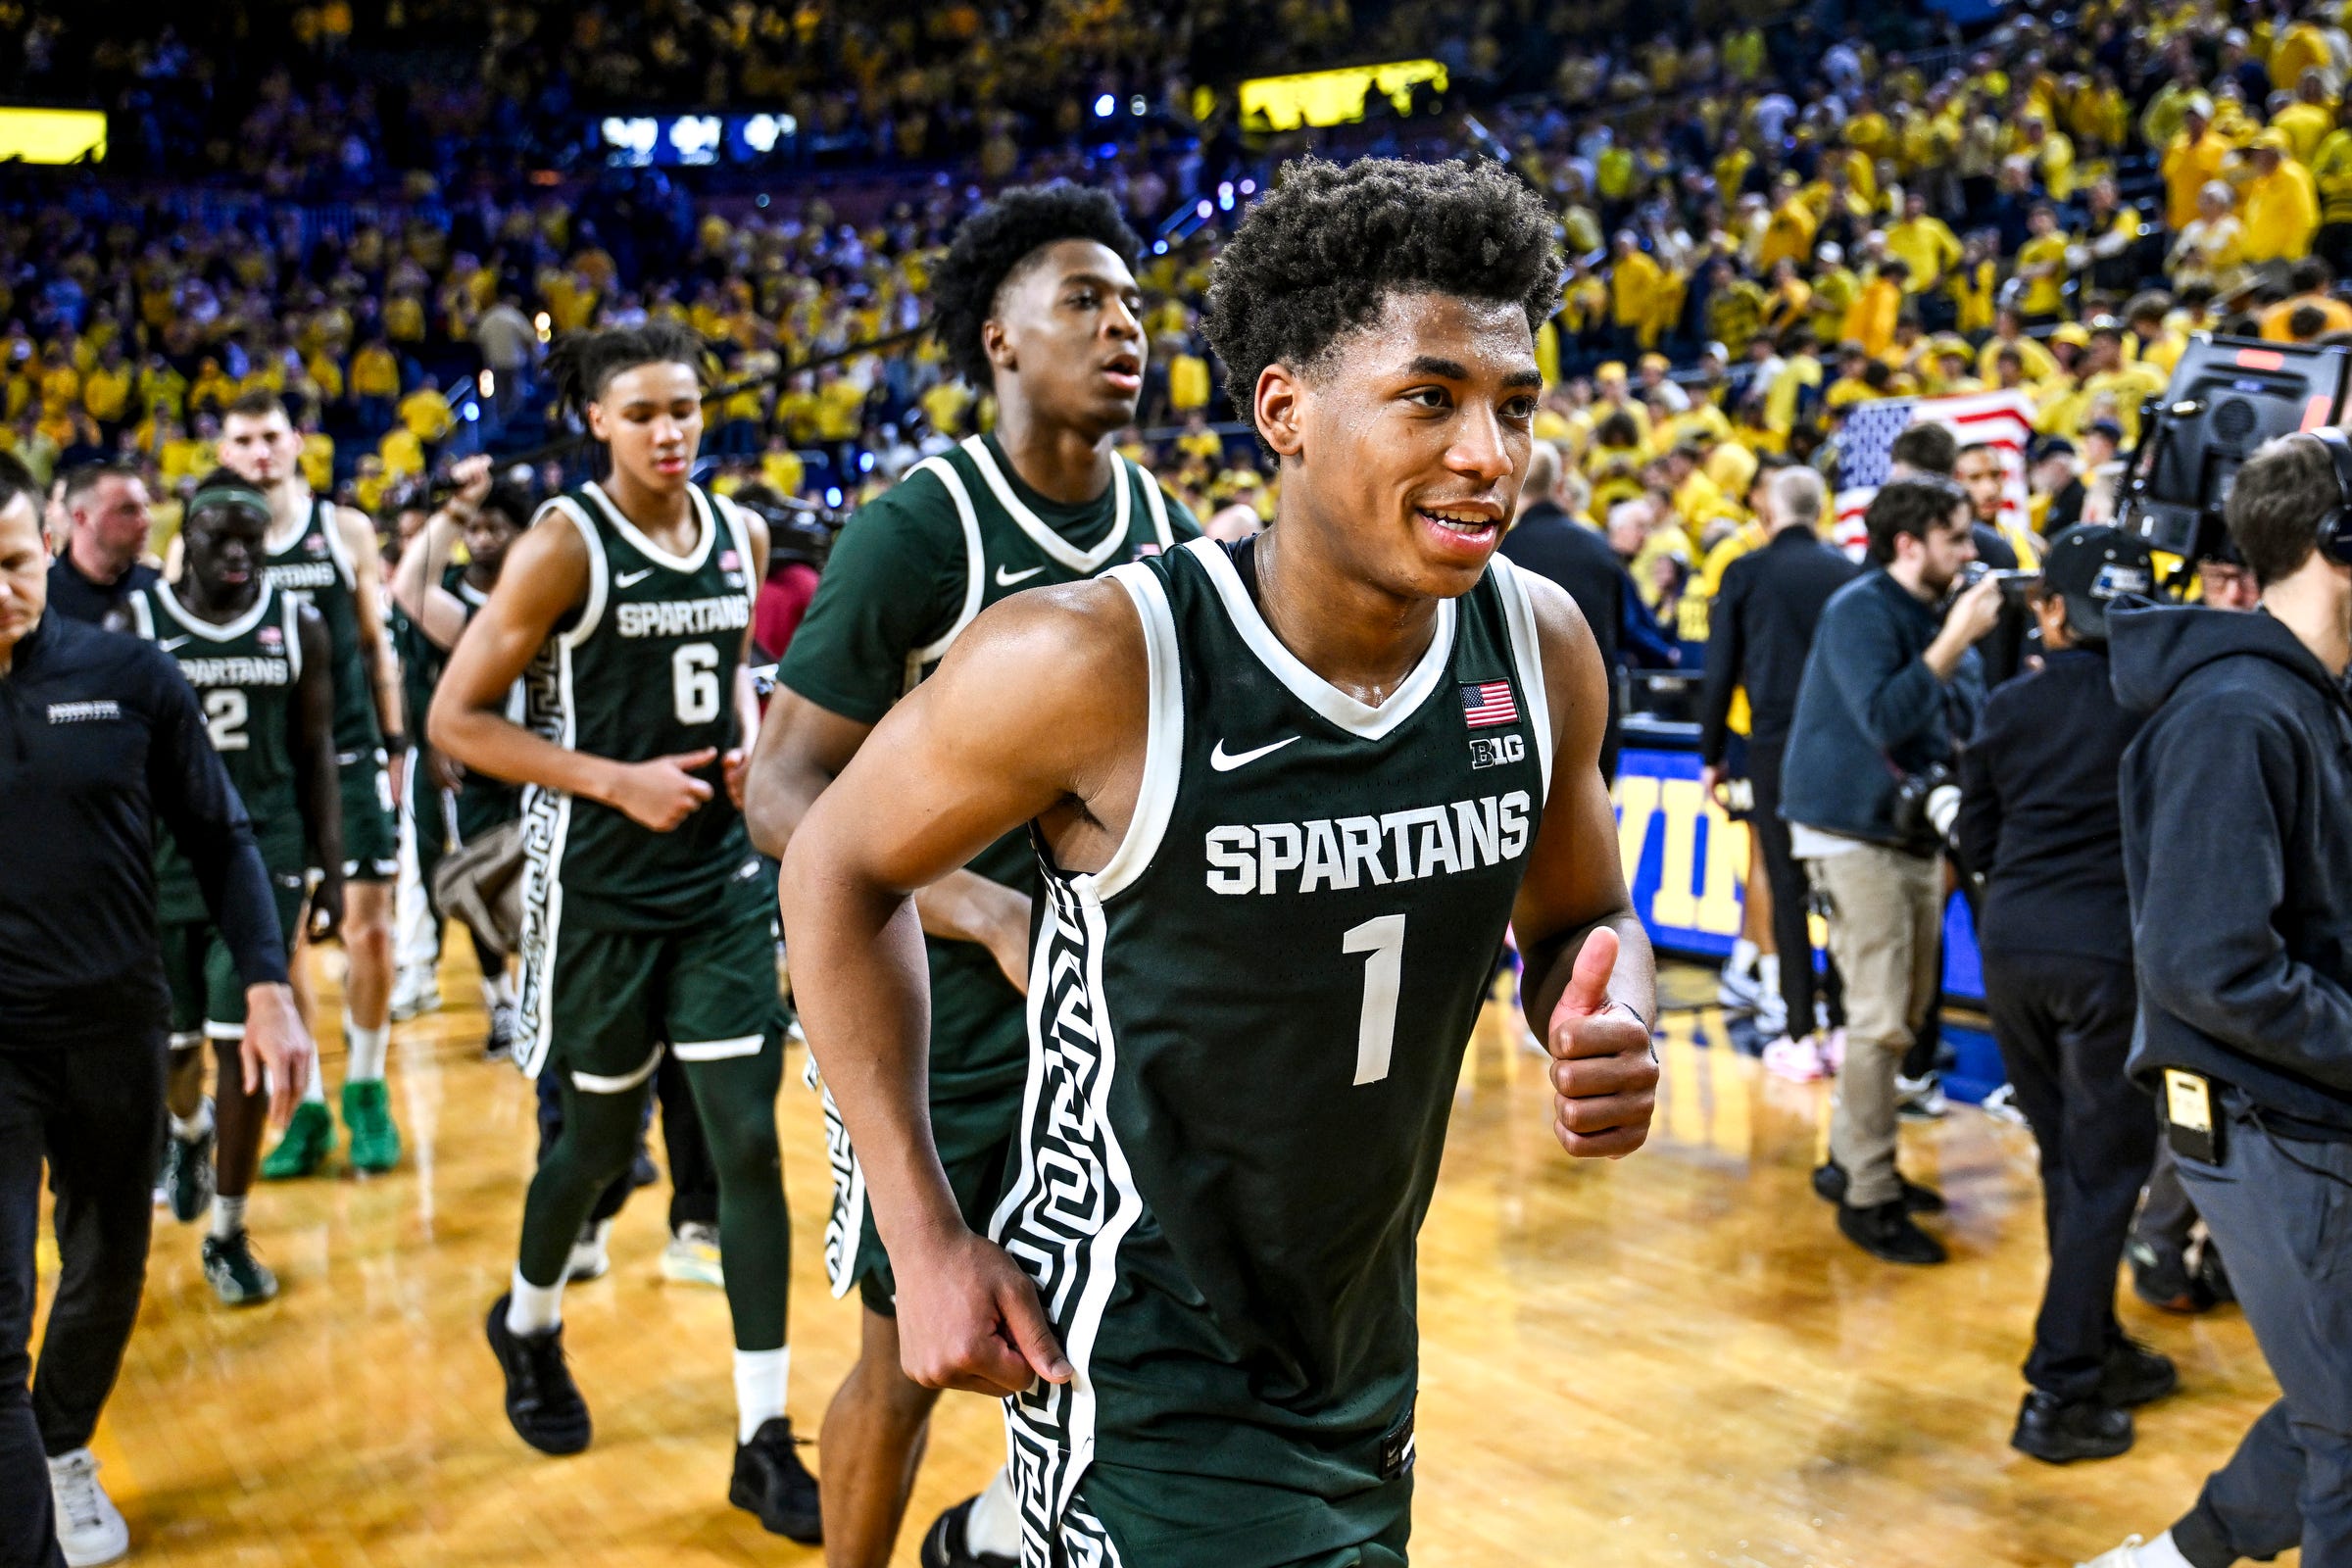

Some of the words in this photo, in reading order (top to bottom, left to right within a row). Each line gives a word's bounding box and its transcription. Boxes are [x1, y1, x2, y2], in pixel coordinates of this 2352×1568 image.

[616, 595, 749, 637] SPARTANS
[178, 657, 288, 686] PARTANS
[672, 642, 719, 725] 6
[204, 688, 249, 751] 2
[1205, 790, 1531, 895] SPARTANS
[1343, 913, 1406, 1086] 1
